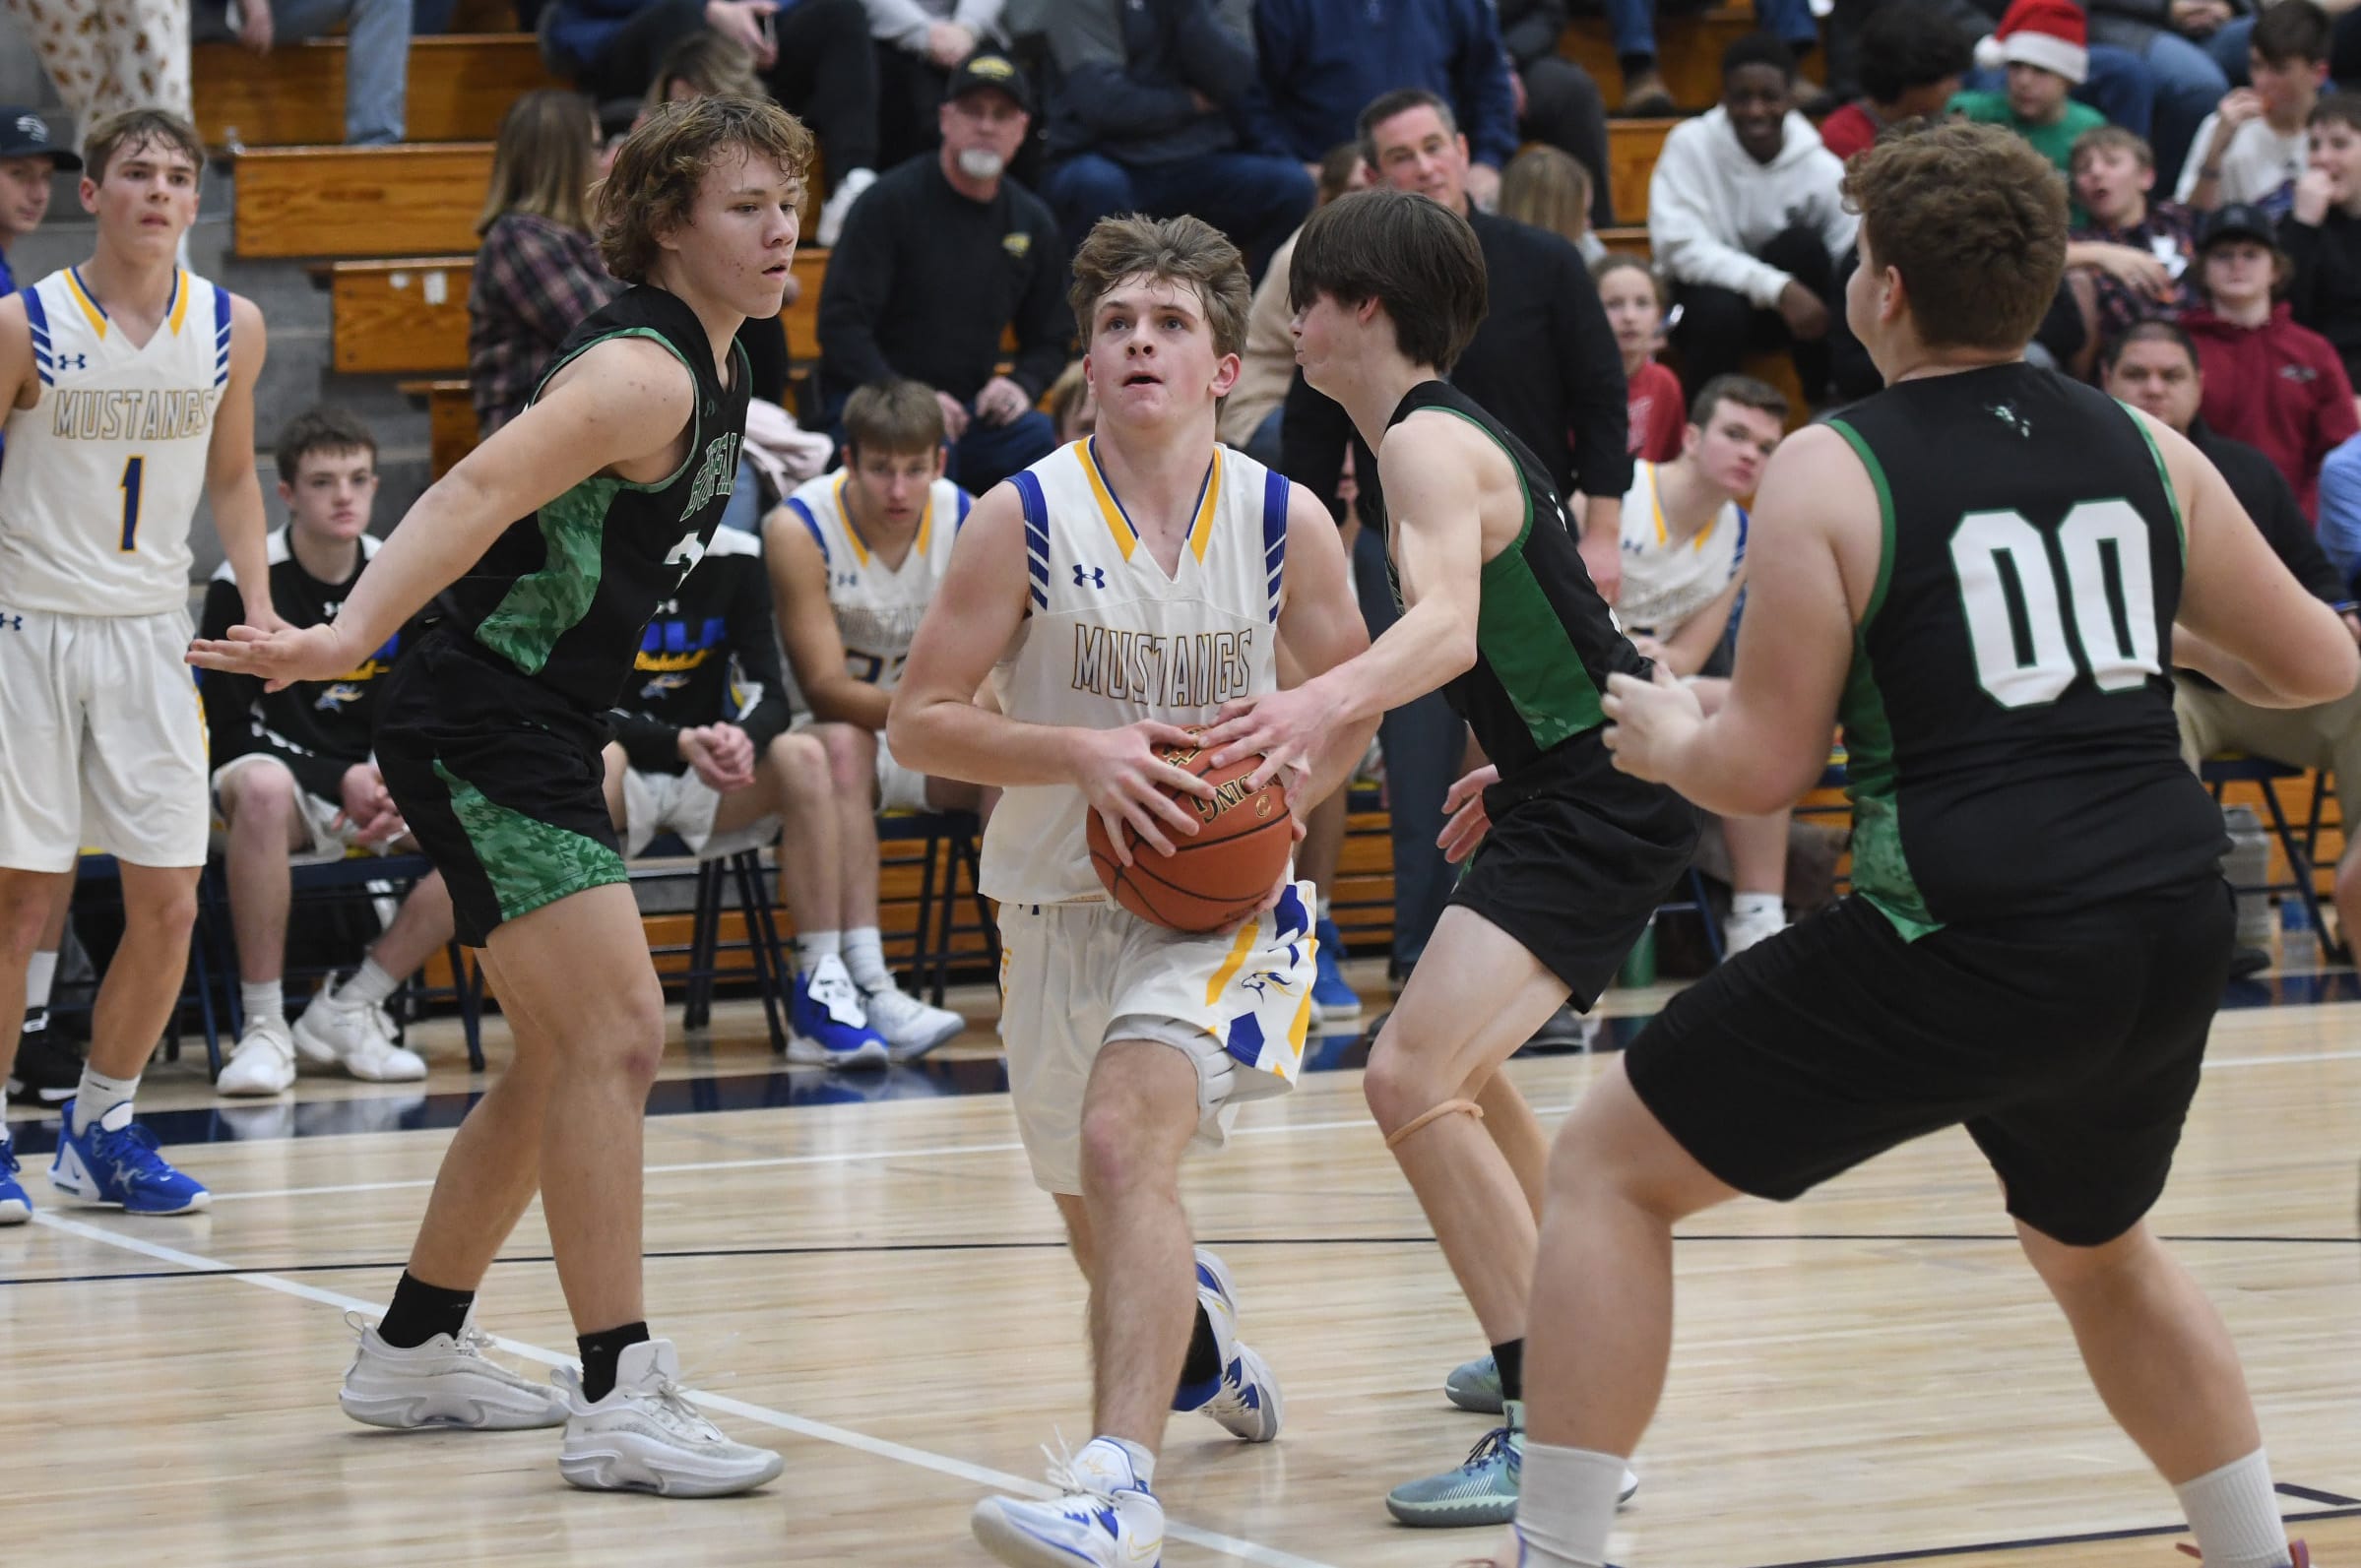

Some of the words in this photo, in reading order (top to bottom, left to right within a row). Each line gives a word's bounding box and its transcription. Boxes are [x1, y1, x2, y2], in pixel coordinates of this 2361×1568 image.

[52, 389, 214, 441] MUSTANGS
[118, 454, 146, 553] 1
[1947, 497, 2162, 711] 00
[1071, 622, 1252, 709] MUSTANGS
